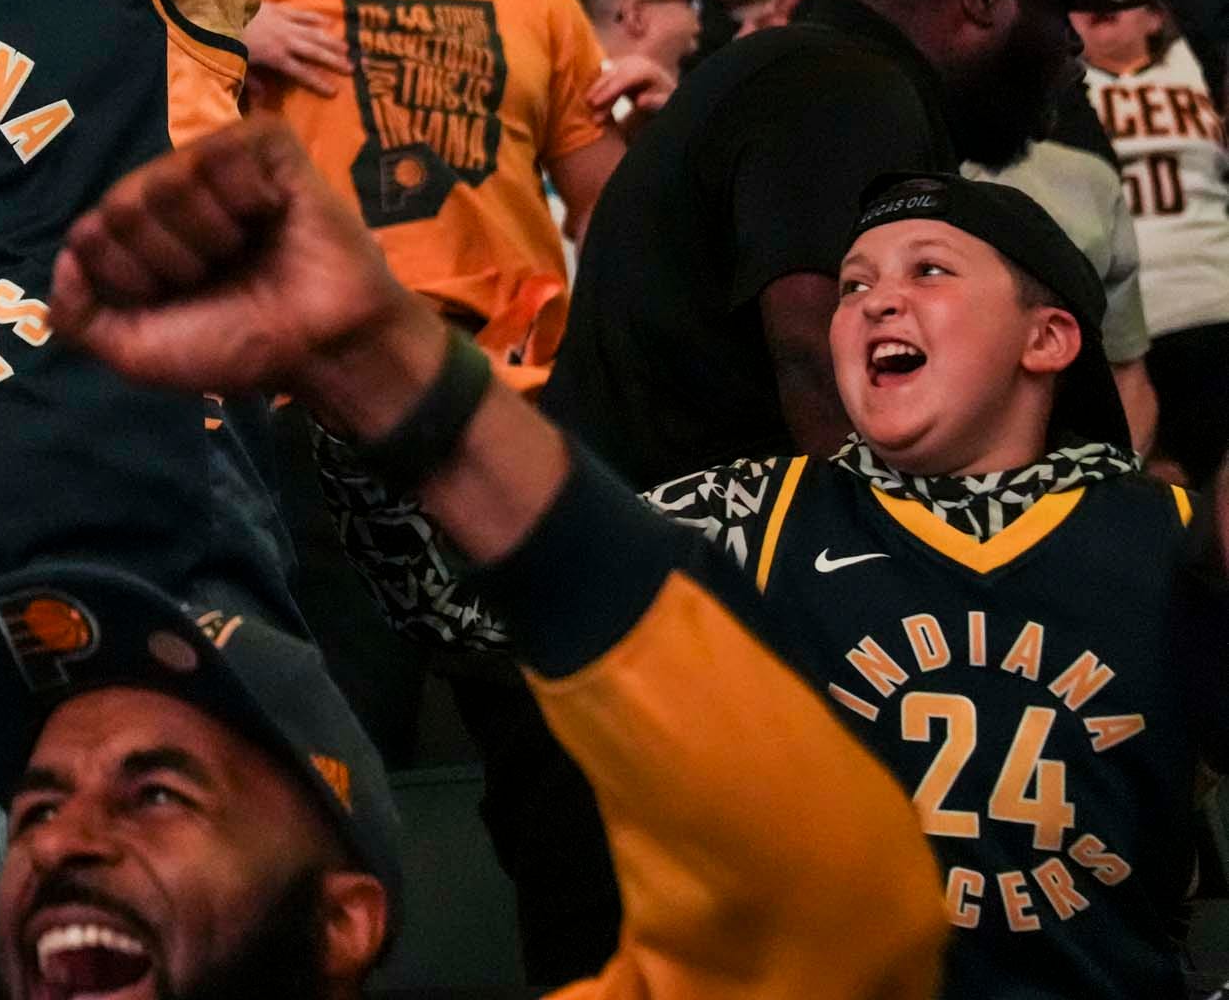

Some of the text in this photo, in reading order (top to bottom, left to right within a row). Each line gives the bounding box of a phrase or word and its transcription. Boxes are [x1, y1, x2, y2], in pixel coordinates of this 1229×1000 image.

[1101, 85, 1226, 142] CERS
[828, 611, 1145, 753] INDIANA
[901, 691, 1075, 851] 24
[945, 833, 1132, 933] CERS
